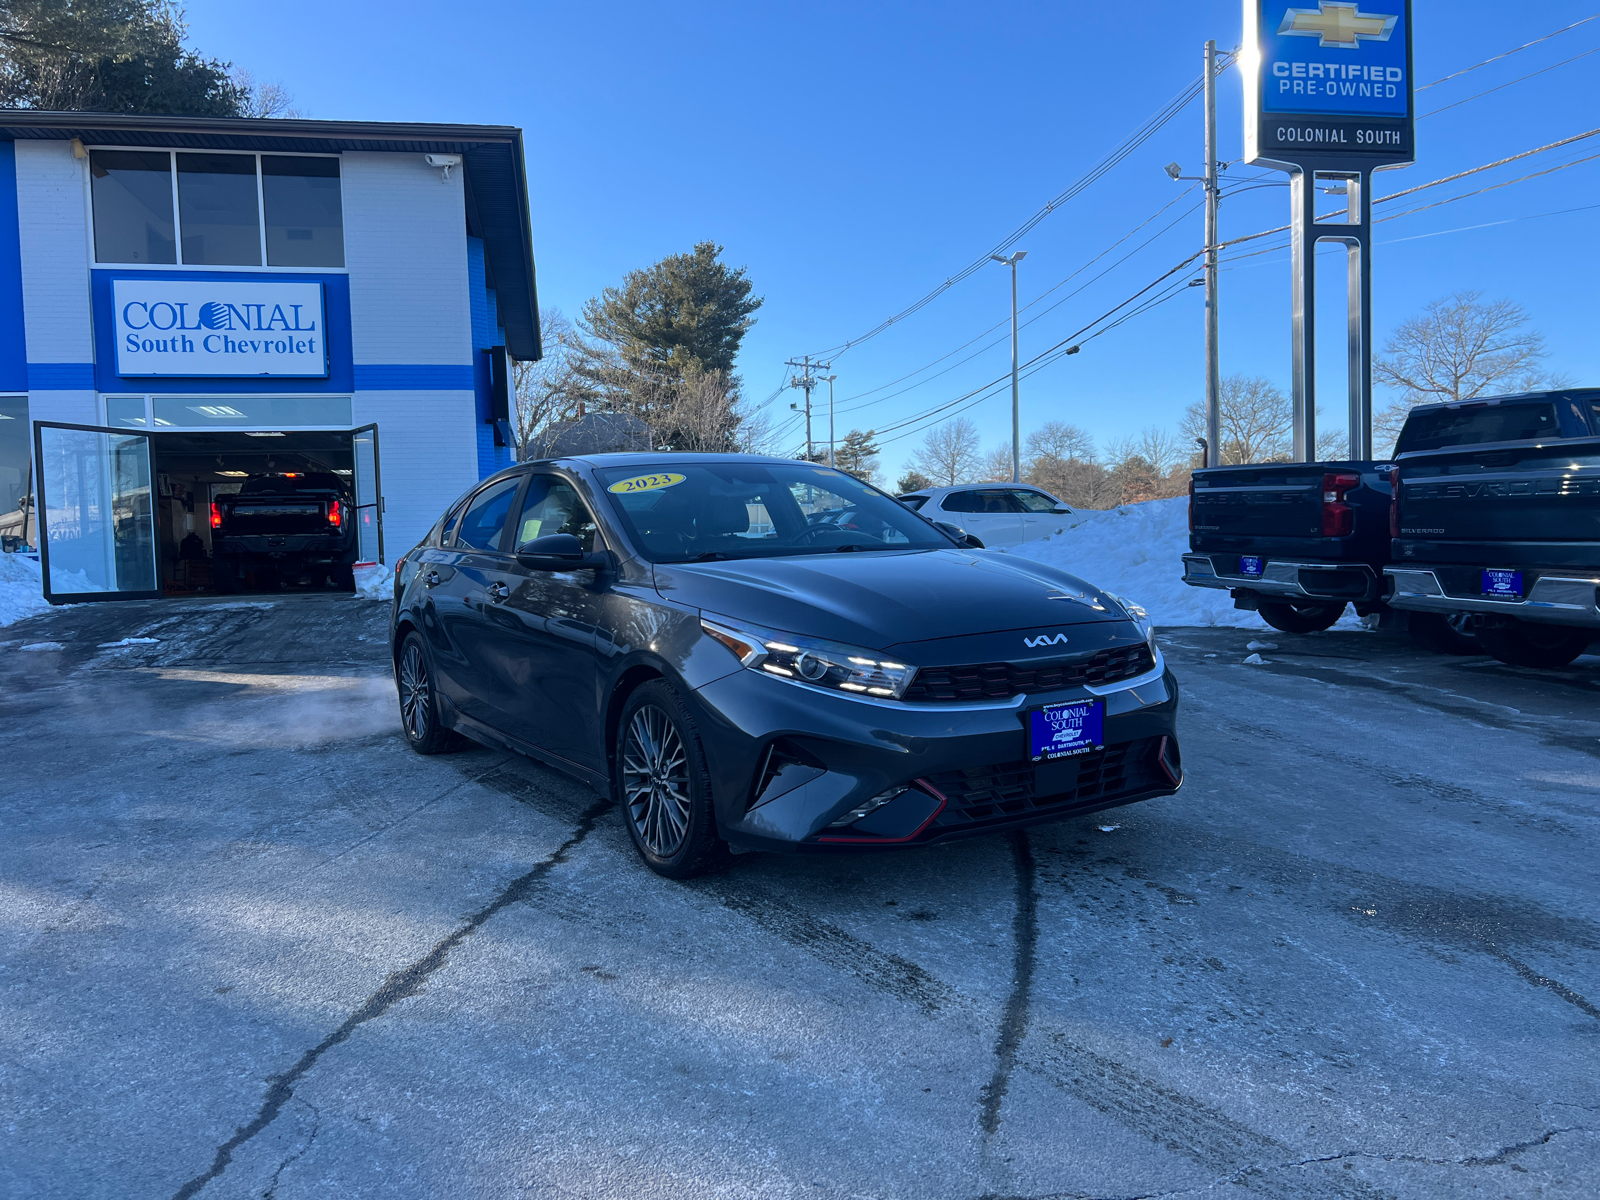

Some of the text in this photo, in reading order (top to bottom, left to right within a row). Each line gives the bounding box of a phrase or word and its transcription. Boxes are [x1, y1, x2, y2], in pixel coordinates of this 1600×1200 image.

[1273, 61, 1402, 82] CERTIFIED
[1279, 79, 1397, 98] PRE-OWNED
[1276, 127, 1401, 144] COLONIAL SOUTH
[123, 301, 316, 332] COLONIAL
[126, 333, 316, 354] South Chevrolet
[623, 474, 672, 491] 2023
[1023, 633, 1068, 648] KIA
[1044, 706, 1090, 722] COLONIAL
[1051, 717, 1083, 731] SOUTH
[1047, 747, 1090, 760] COLONIAL SOUTH
